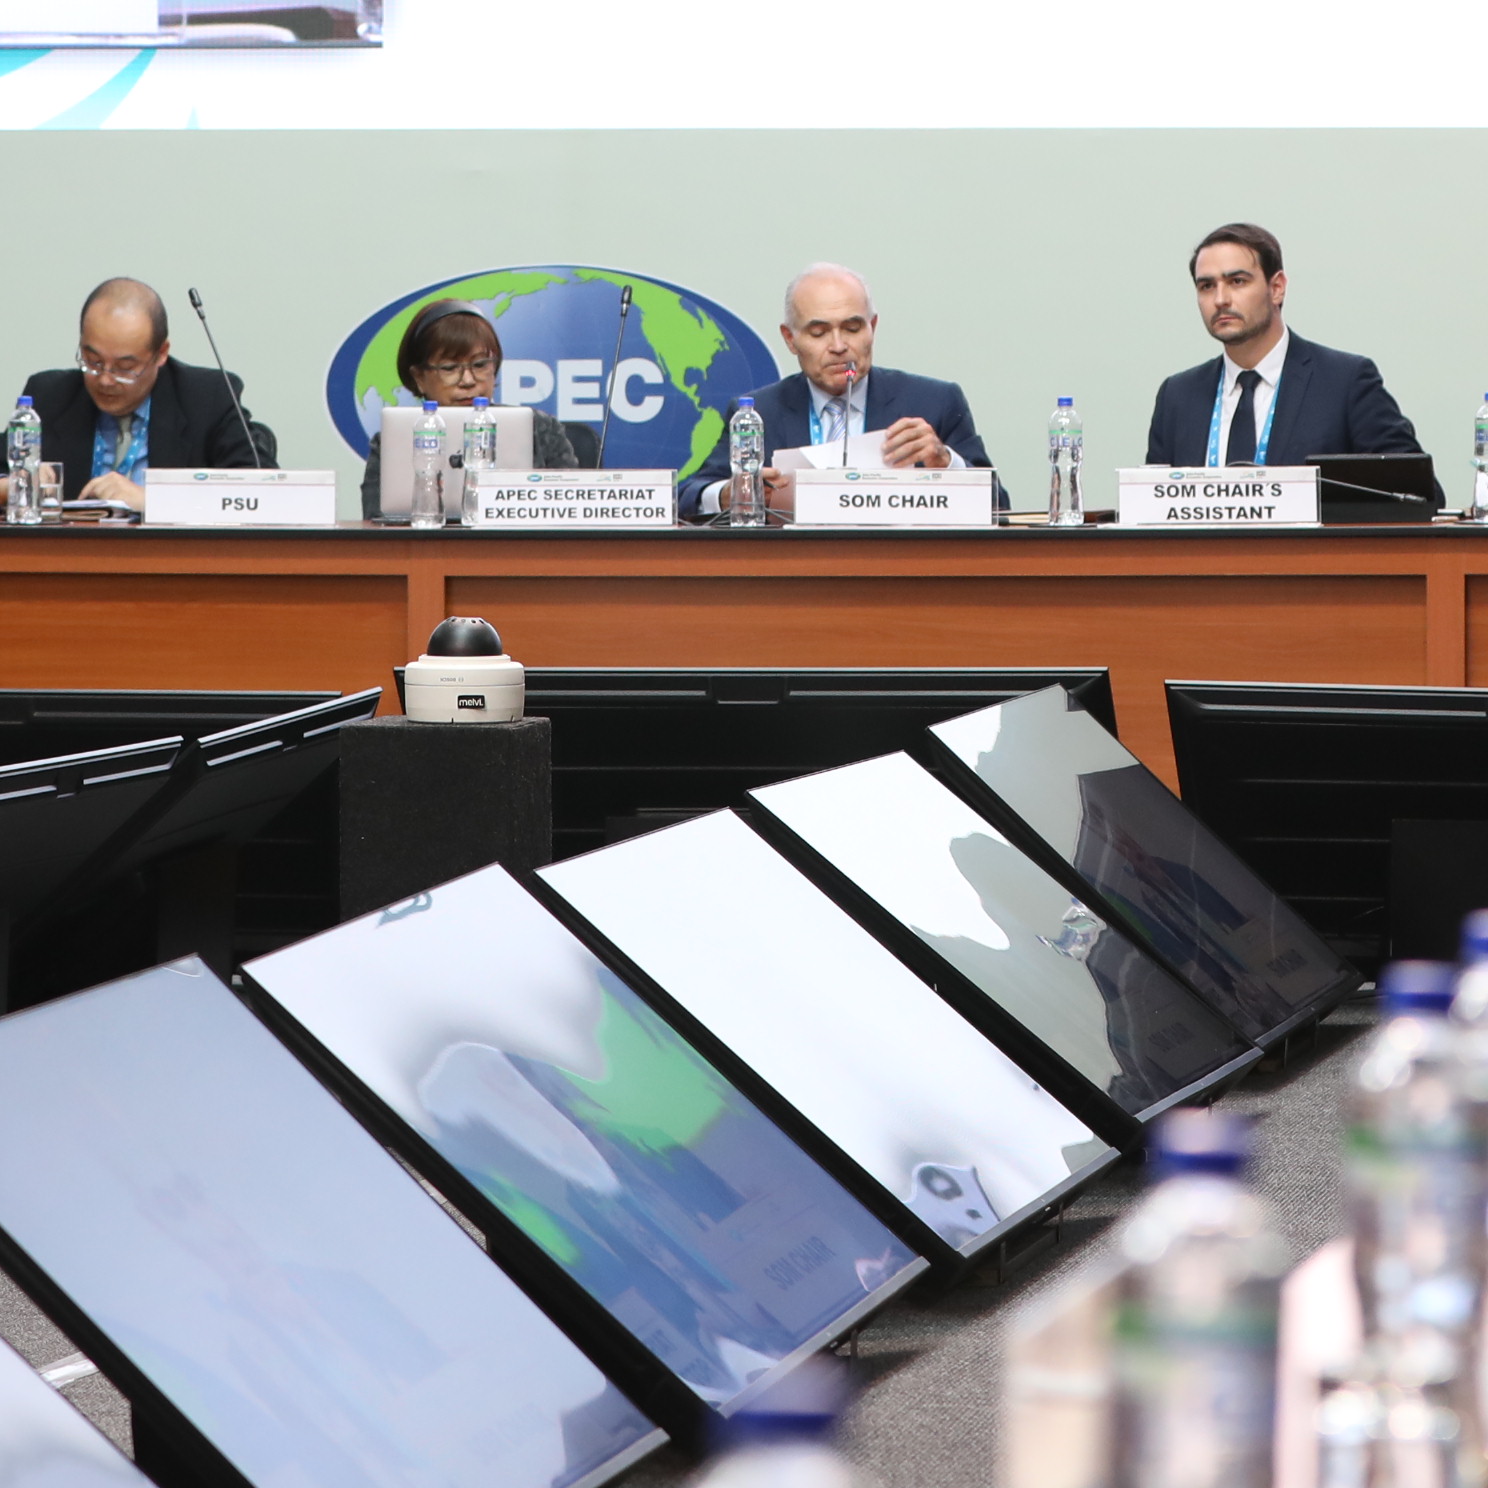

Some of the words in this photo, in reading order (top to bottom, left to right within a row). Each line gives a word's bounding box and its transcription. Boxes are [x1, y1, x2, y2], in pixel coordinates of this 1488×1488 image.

[497, 358, 665, 423] PEC
[495, 489, 537, 501] APEC
[543, 488, 655, 501] SECRETARIAT
[1154, 484, 1196, 498] SOM
[221, 497, 259, 511] PSU
[839, 494, 881, 508] SOM
[887, 494, 948, 509] CHAIR
[485, 507, 577, 519] EXECUTIVE
[583, 507, 666, 519] DIRECTOR
[1166, 506, 1276, 520] ASSISTANT
